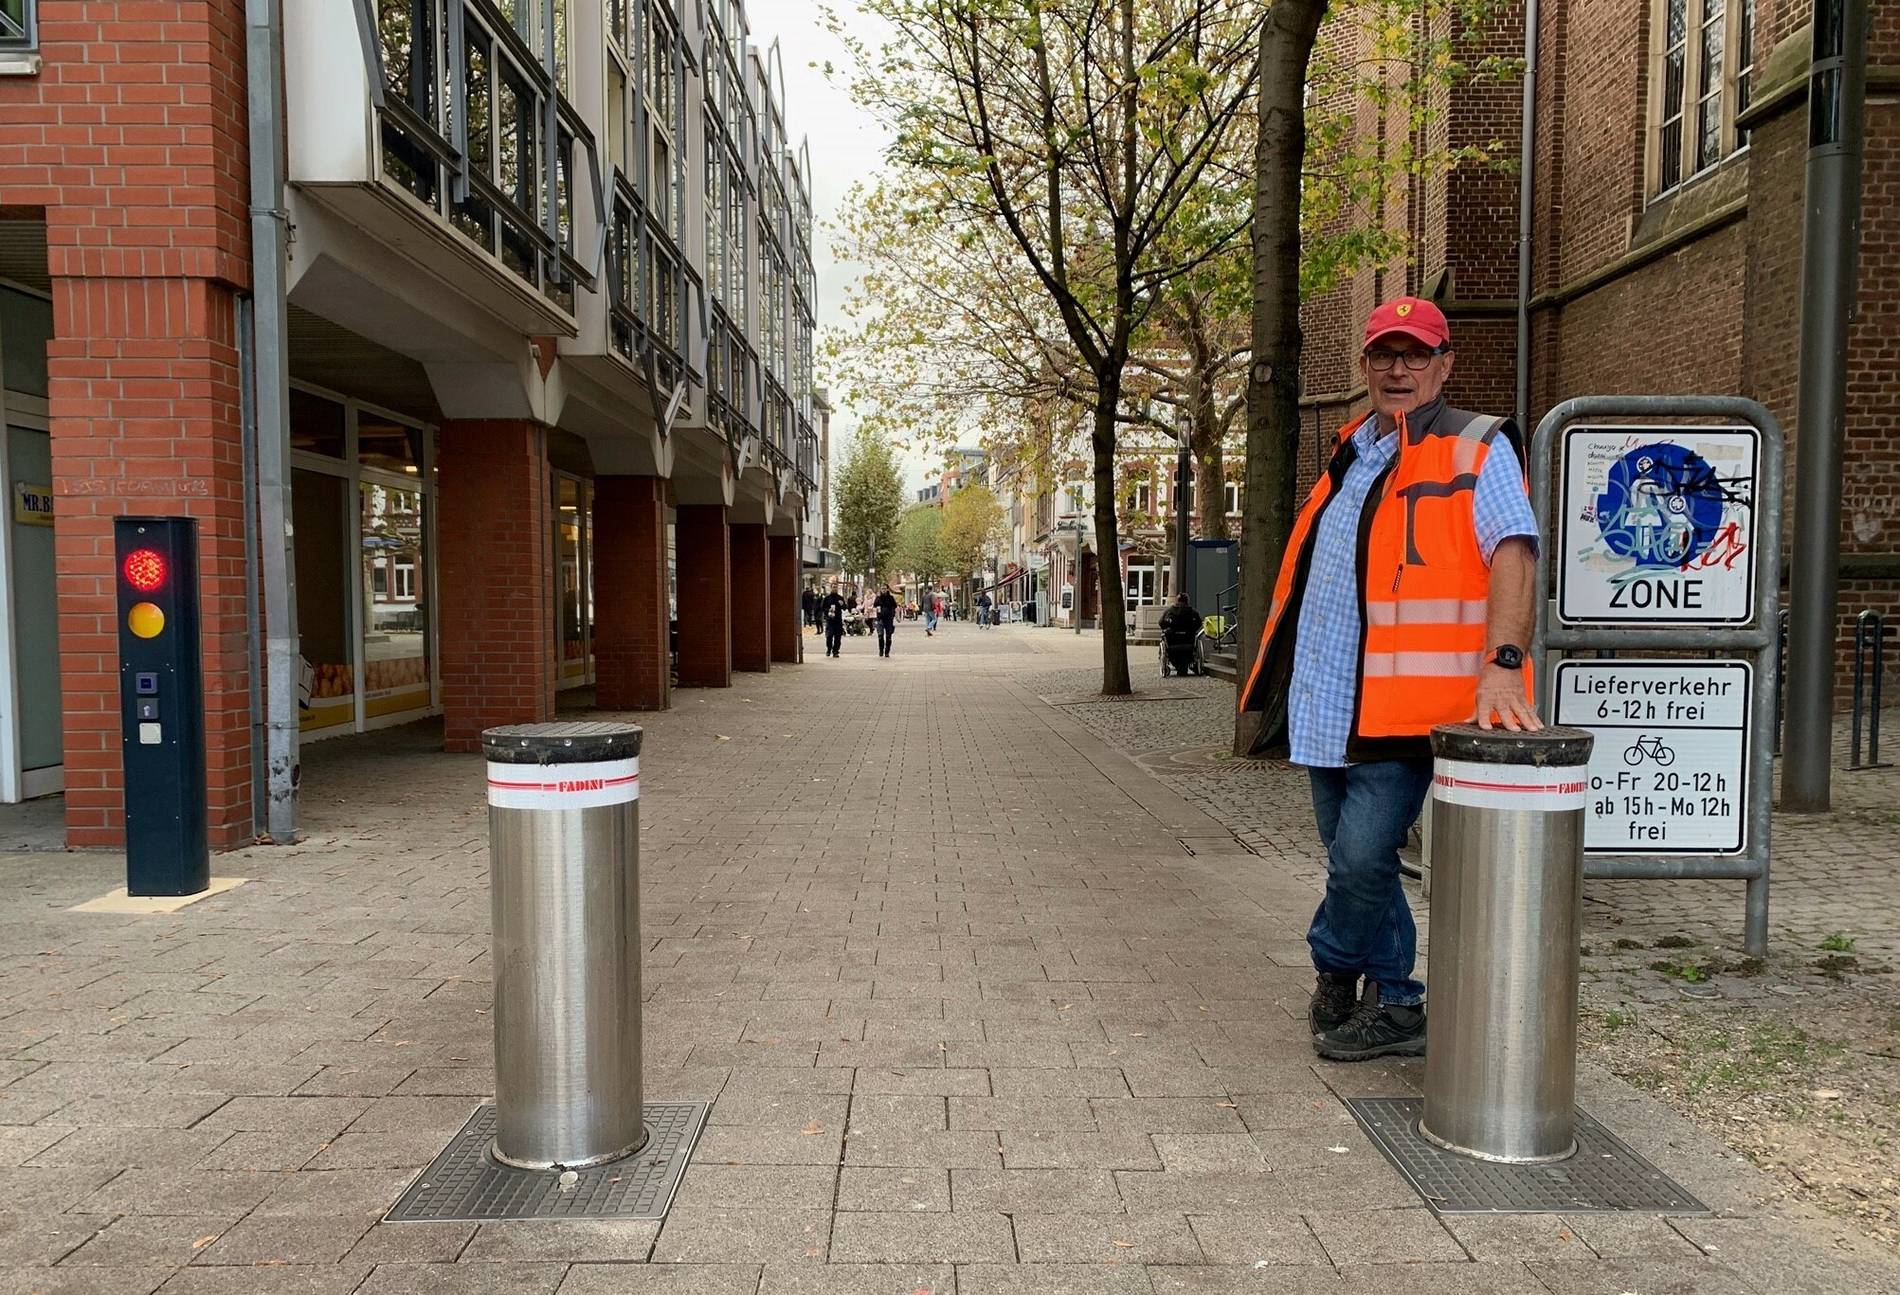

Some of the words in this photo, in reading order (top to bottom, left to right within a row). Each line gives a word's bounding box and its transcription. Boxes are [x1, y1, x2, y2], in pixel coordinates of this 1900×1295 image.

[23, 494, 54, 512] MR.B
[1609, 580, 1703, 608] ZONE
[1574, 675, 1731, 696] Lieferverkehr
[1667, 701, 1705, 720] frei
[559, 779, 603, 792] FADINI
[1590, 772, 1641, 791] o-Fr
[1595, 797, 1614, 815] ab
[1702, 798, 1730, 816] 12h
[1629, 821, 1666, 840] frei
